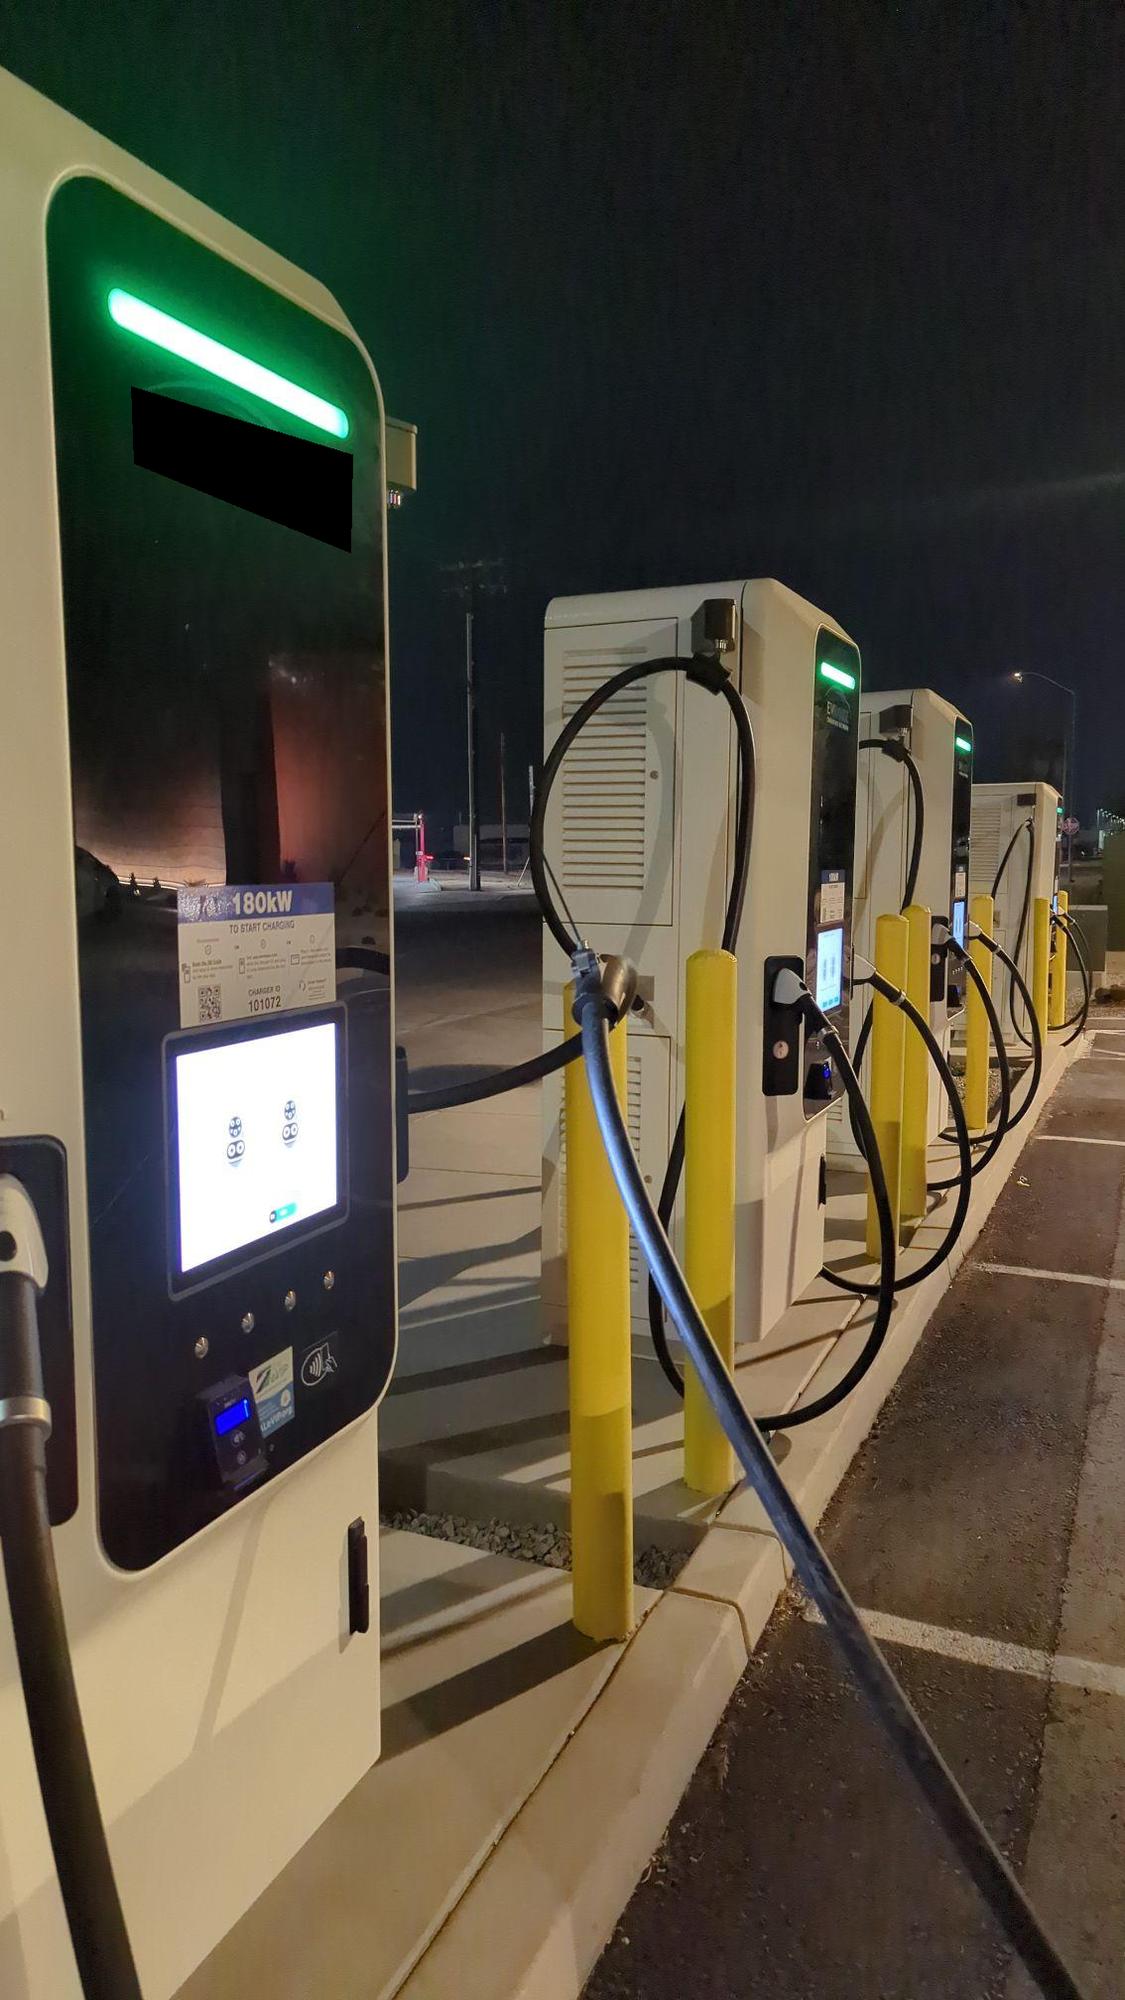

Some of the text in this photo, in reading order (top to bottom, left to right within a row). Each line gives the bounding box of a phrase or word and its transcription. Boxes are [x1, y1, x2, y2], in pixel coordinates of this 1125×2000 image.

[232, 890, 293, 915] 180kW
[229, 920, 295, 934] TO START CHARGING
[248, 986, 275, 996] CHARGER
[248, 995, 282, 1013] 101072
